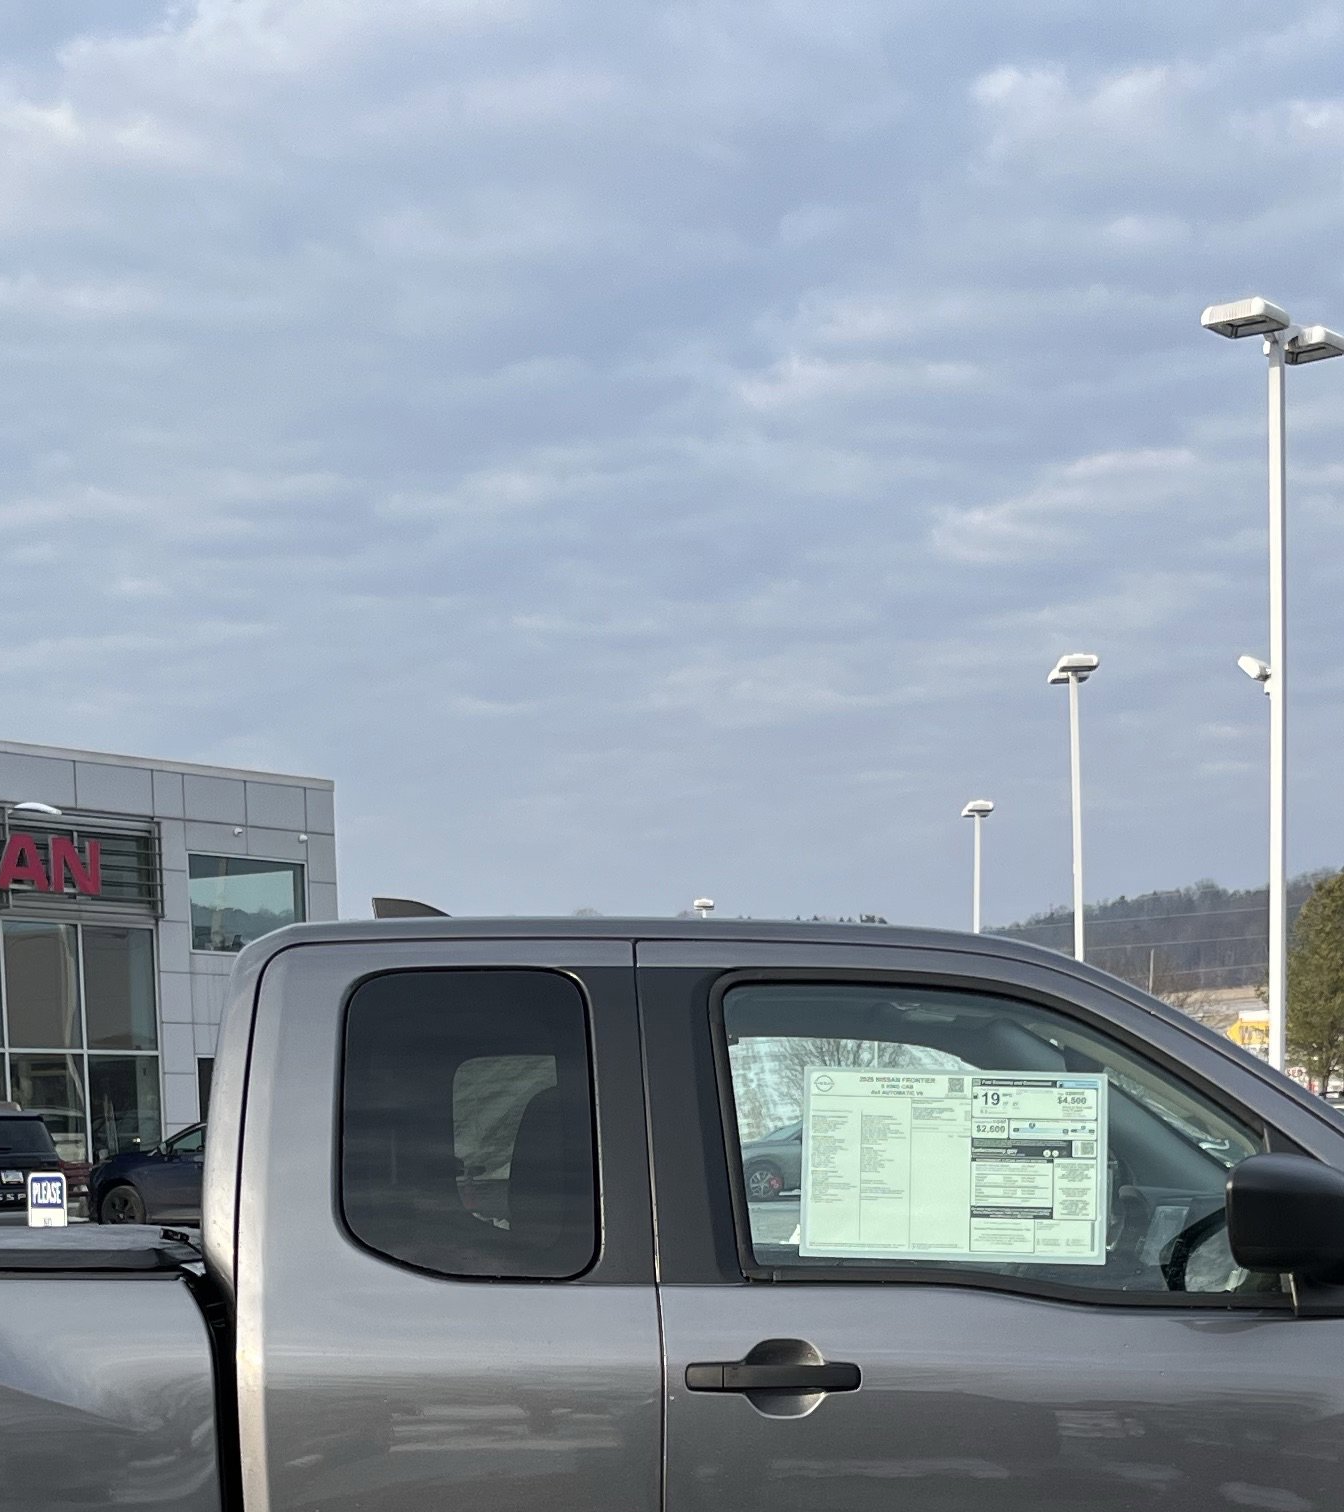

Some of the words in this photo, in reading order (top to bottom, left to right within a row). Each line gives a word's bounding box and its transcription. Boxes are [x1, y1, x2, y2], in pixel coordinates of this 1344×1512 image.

[982, 1092, 1000, 1106] 19
[1057, 1097, 1087, 1105] $4,500
[32, 1180, 62, 1204] PLEASE
